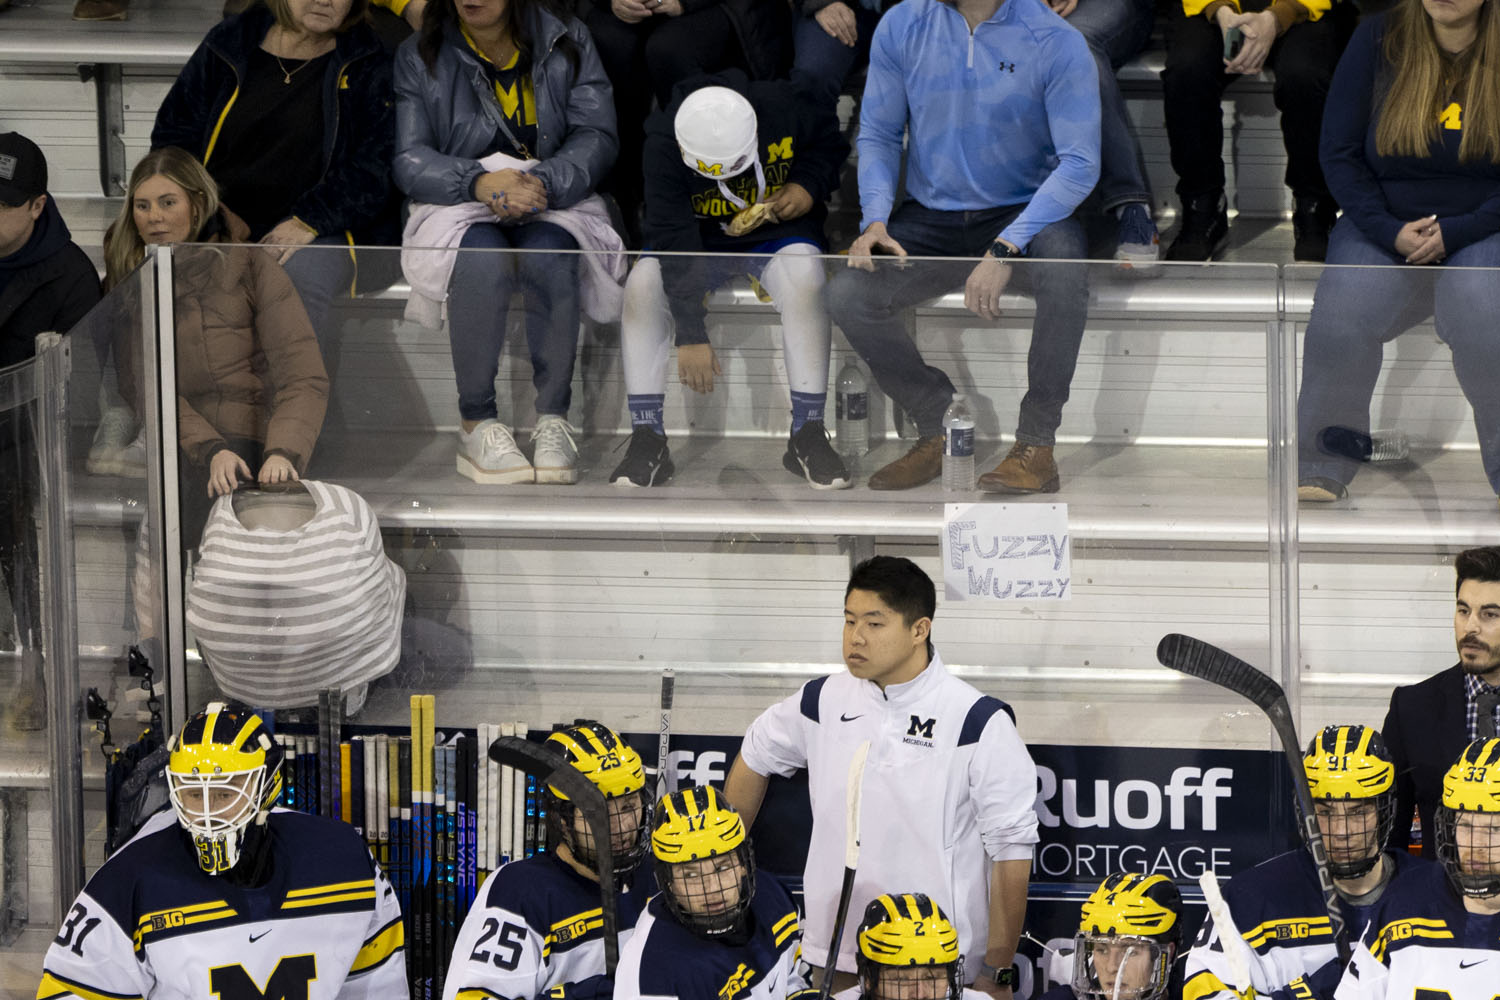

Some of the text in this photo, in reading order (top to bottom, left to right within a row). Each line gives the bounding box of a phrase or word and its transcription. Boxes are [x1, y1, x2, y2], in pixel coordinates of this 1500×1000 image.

[768, 137, 794, 164] M
[696, 158, 723, 176] M
[907, 715, 936, 739] M
[660, 713, 669, 770] VAPOR
[597, 752, 622, 771] 25
[1328, 756, 1348, 772] 91
[1463, 766, 1487, 783] 33
[688, 813, 706, 832] 17
[195, 835, 231, 873] 31
[457, 830, 465, 887] SYNC
[1032, 843, 1232, 880] ORTGAGE
[1305, 814, 1345, 940] VAPOR
[54, 902, 101, 958] 31
[914, 921, 925, 936] 2
[469, 917, 528, 972] 25
